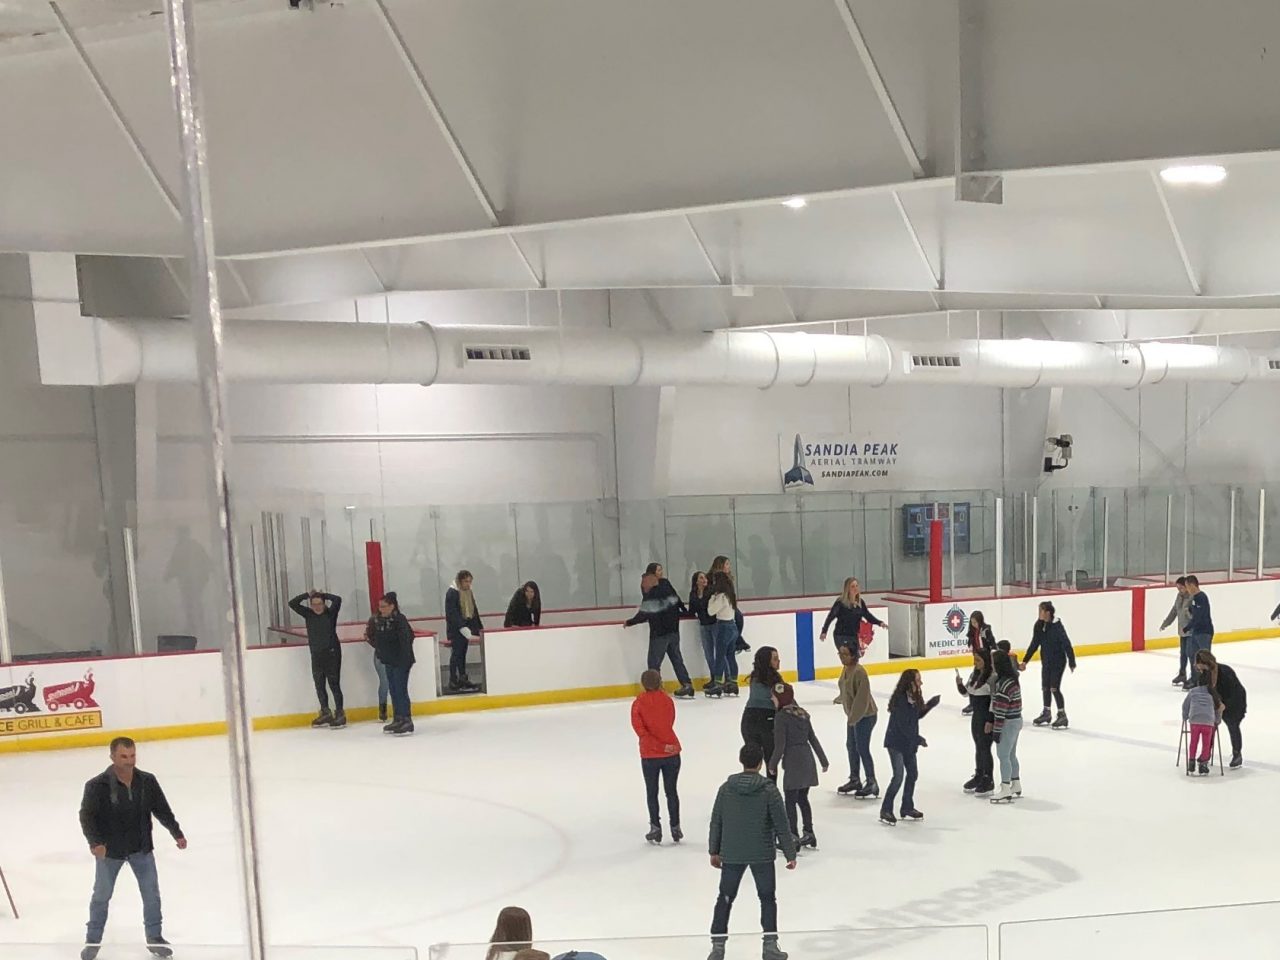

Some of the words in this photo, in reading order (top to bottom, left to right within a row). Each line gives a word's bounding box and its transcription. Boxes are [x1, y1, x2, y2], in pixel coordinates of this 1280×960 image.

[805, 443, 858, 457] SANDIA
[863, 443, 898, 456] PEAK
[810, 458, 846, 467] AERIAL
[851, 458, 897, 466] TRAMWAY
[821, 469, 889, 478] SANDIAPEAK.COM
[929, 639, 955, 648] MEDIC
[18, 718, 52, 731] GRILL
[54, 719, 62, 728] &
[64, 714, 94, 727] CAFE
